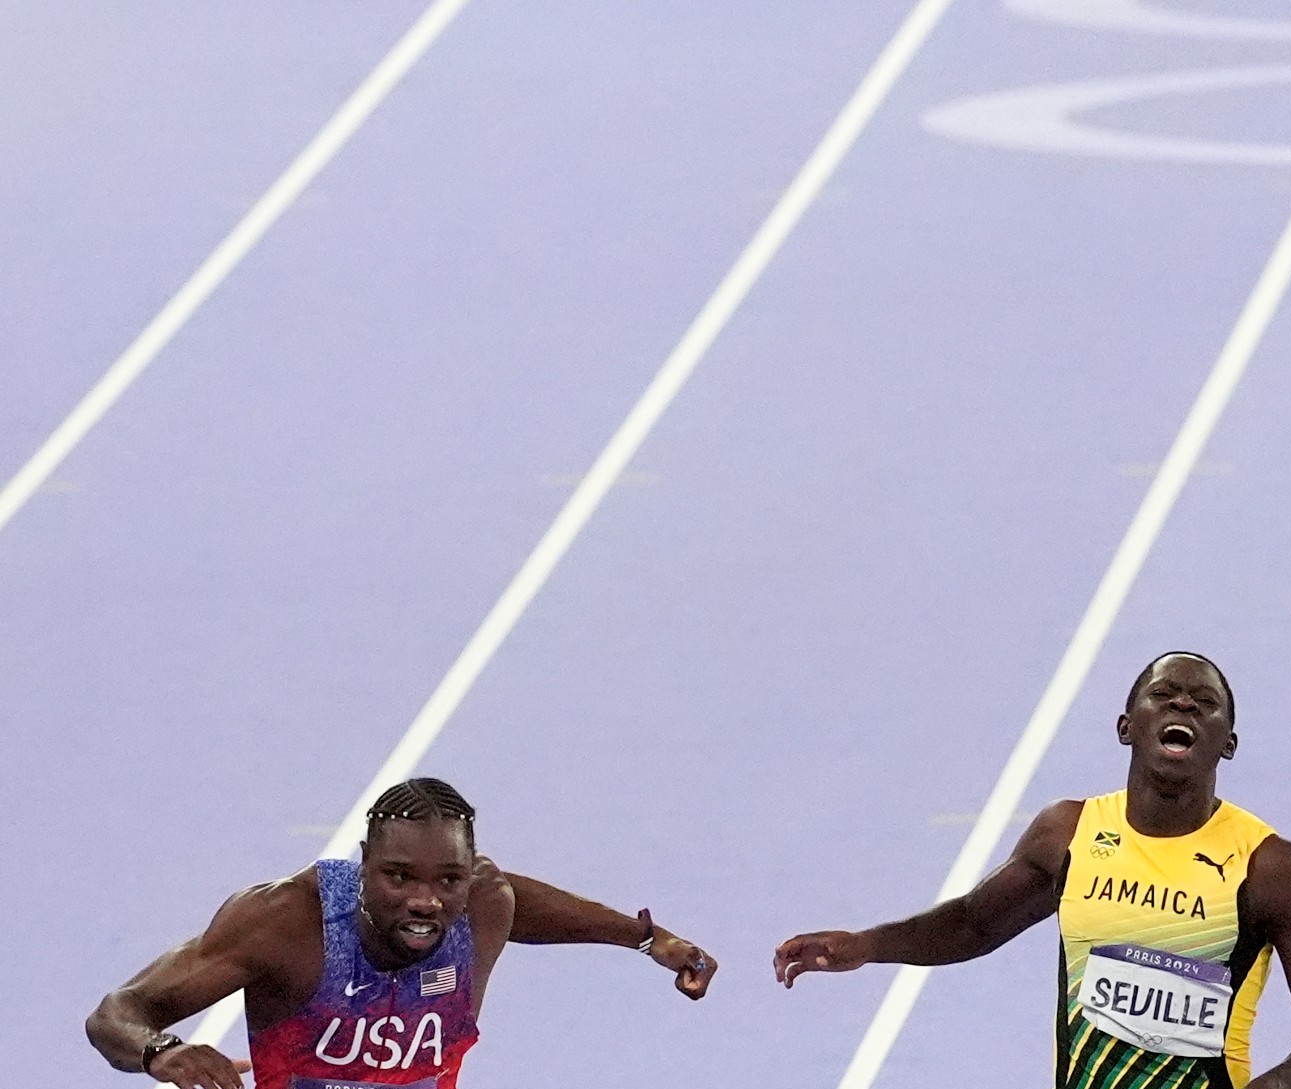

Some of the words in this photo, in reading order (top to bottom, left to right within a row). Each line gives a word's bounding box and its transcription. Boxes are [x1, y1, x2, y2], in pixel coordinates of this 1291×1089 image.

[1083, 876, 1206, 920] JAMAICA
[1125, 948, 1161, 965] PARIS
[1164, 957, 1199, 975] 2024
[1090, 977, 1218, 1028] SEVILLE
[315, 1012, 443, 1069] USA
